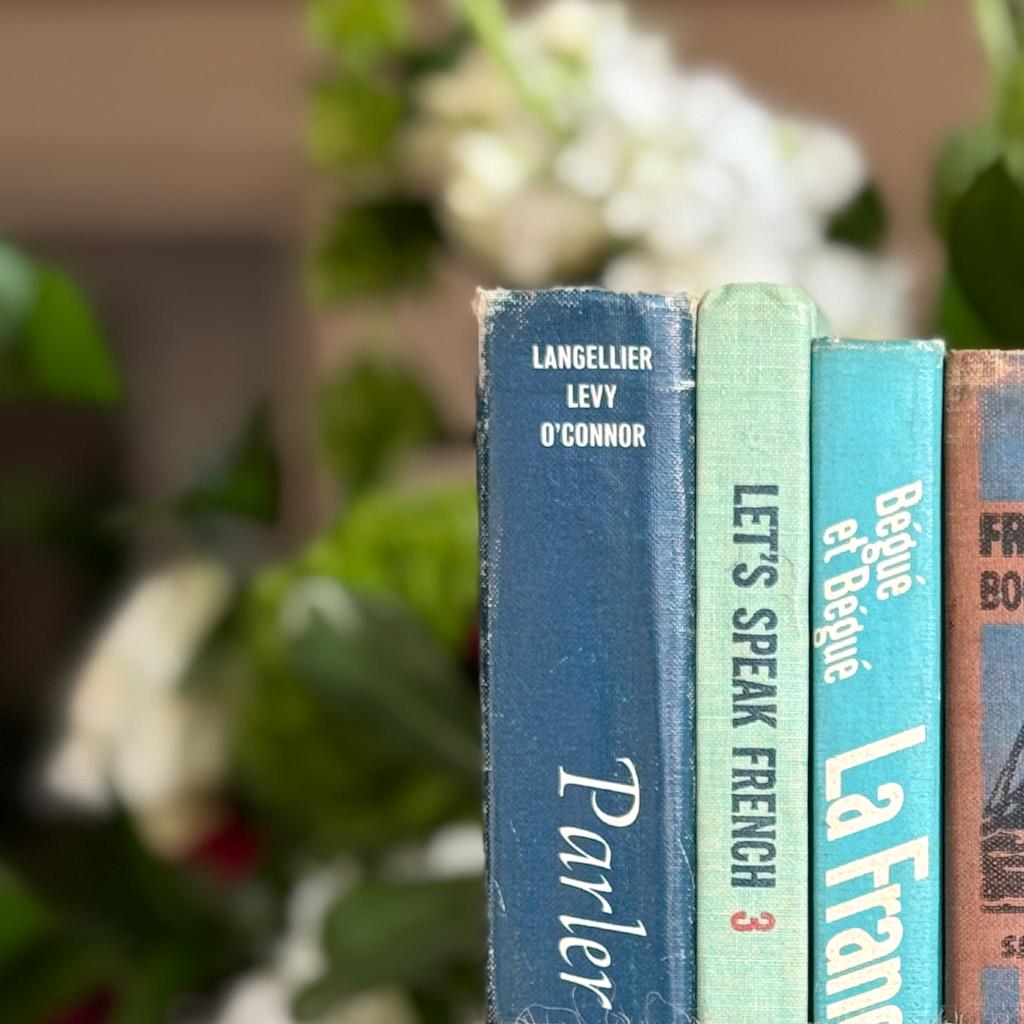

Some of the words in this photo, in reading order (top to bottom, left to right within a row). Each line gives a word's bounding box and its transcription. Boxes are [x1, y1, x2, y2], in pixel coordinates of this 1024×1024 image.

[532, 344, 653, 371] LANGELLIER
[567, 383, 617, 409] LEVY
[540, 421, 647, 448] O'CONNOR
[731, 484, 779, 589] LET'S
[823, 517, 869, 564] et
[861, 479, 927, 601] Bégué
[731, 606, 778, 729] SPEAK
[813, 565, 873, 684] Bégué
[731, 746, 778, 889] FRENCH
[824, 725, 927, 842] La
[558, 757, 648, 1011] Parler
[730, 911, 776, 933] 3
